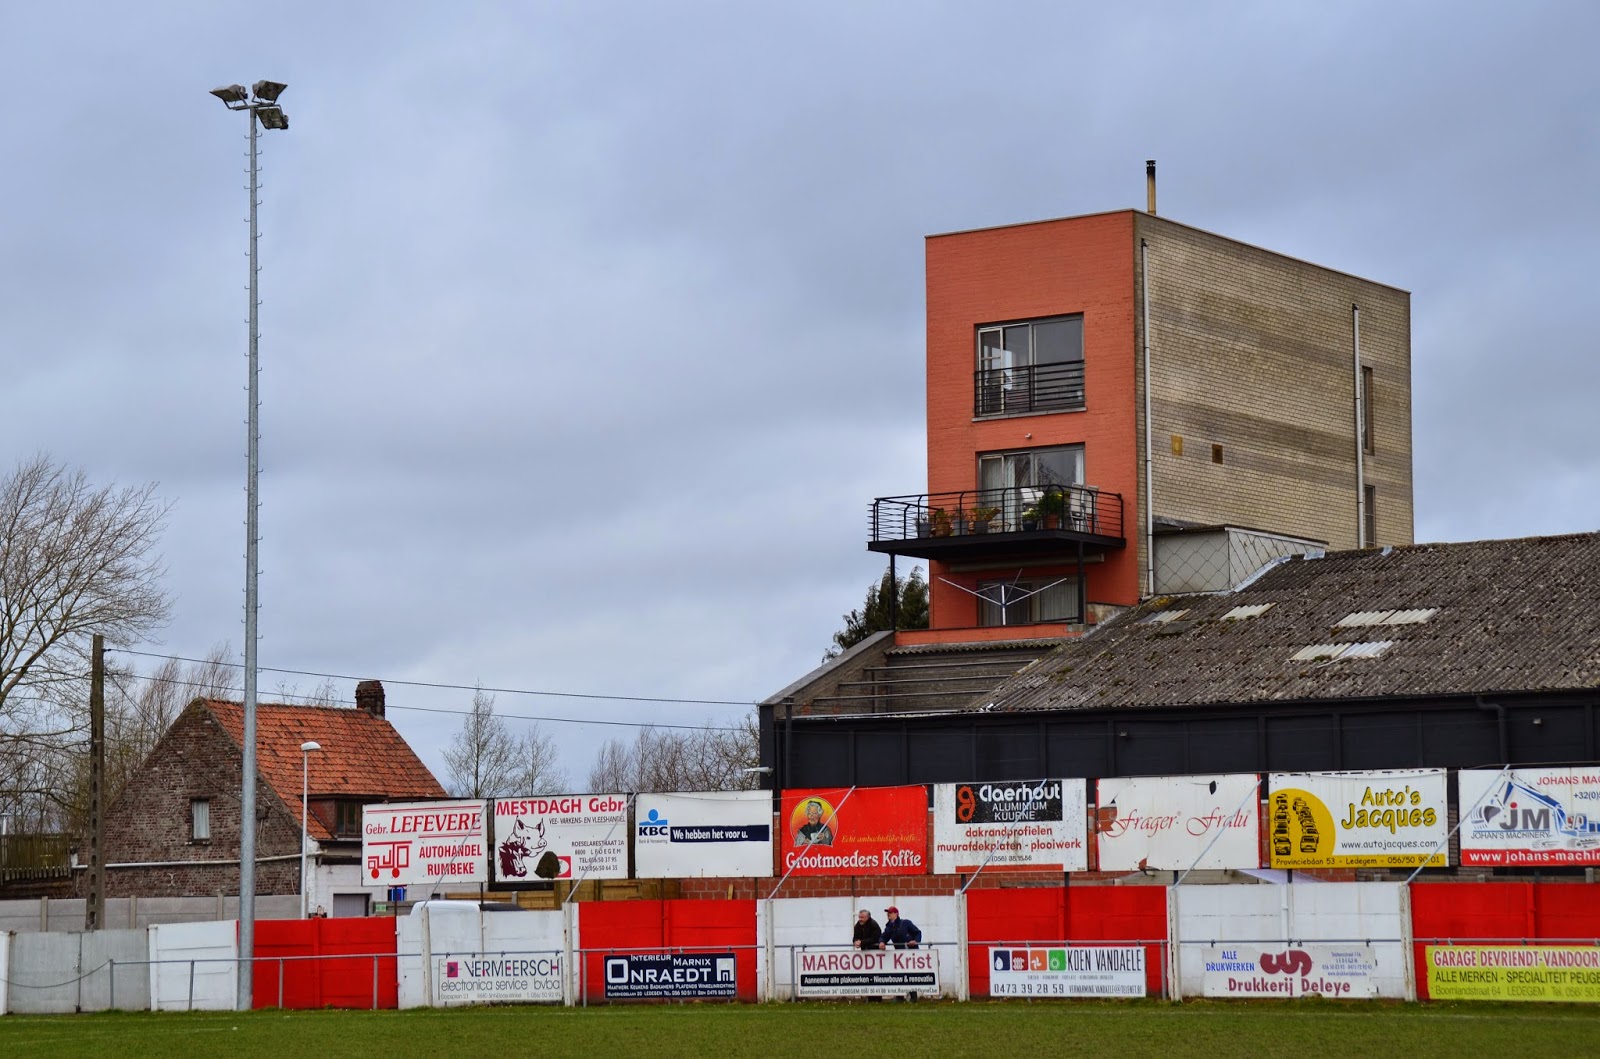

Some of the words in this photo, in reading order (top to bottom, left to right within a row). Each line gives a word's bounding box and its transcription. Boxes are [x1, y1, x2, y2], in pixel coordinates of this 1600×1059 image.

[1537, 776, 1579, 785] JOHANS
[979, 784, 1060, 802] Claerhout
[1361, 785, 1421, 807] Auto's
[496, 799, 581, 816] MESTDAGH
[589, 797, 625, 813] Gebr.
[992, 802, 1047, 812] ALUMINIUM
[994, 811, 1035, 821] KUURNE
[1186, 807, 1248, 836] Fralu
[1341, 803, 1437, 834] Jacques
[390, 812, 482, 833] LEFEVERE
[366, 824, 388, 834] Gebr.
[639, 827, 668, 836] KBC
[673, 829, 683, 839] We
[685, 829, 710, 839] hebben
[712, 828, 724, 838] het
[725, 830, 740, 838] voor
[966, 825, 1052, 838] dakrandprofielen
[1506, 831, 1550, 839] MACHINERY
[937, 840, 1022, 852] muurafdekplaten
[1031, 839, 1081, 852] plooiwerk
[1341, 839, 1438, 850] www.autojacques.com
[419, 844, 482, 858] AUTOHANDEL
[786, 850, 878, 868] Grootmoeders
[882, 850, 921, 867] Koffie
[1276, 857, 1324, 866] Provinciebaan
[1346, 857, 1377, 866] Ledegem
[428, 862, 474, 876] RUMBEKE
[1067, 950, 1091, 971] KOEN
[1095, 949, 1141, 971] VANDAELE
[1222, 951, 1237, 960] ALLE
[1434, 950, 1477, 967] GARAGE
[465, 959, 560, 977] VERMEERSCH
[673, 958, 711, 966] MARNIX
[802, 954, 886, 971] MARGODT
[894, 953, 932, 969] Krist
[1206, 962, 1255, 972] DRUKWERKEN
[607, 959, 712, 983] ONRAEDT
[1436, 971, 1457, 982] ALLE
[1459, 971, 1498, 982] MERKEN
[441, 980, 492, 991] electronica
[495, 980, 528, 990] service
[534, 979, 560, 990] bvba
[840, 976, 869, 984] plakwerken
[994, 984, 1017, 994] 0473
[1021, 984, 1033, 994] 39
[1037, 984, 1048, 994] 28
[1052, 984, 1064, 994] 59
[1228, 977, 1293, 996] Drukkerij
[1301, 977, 1350, 996] Deleye
[1507, 987, 1545, 996] LEDEGEM
